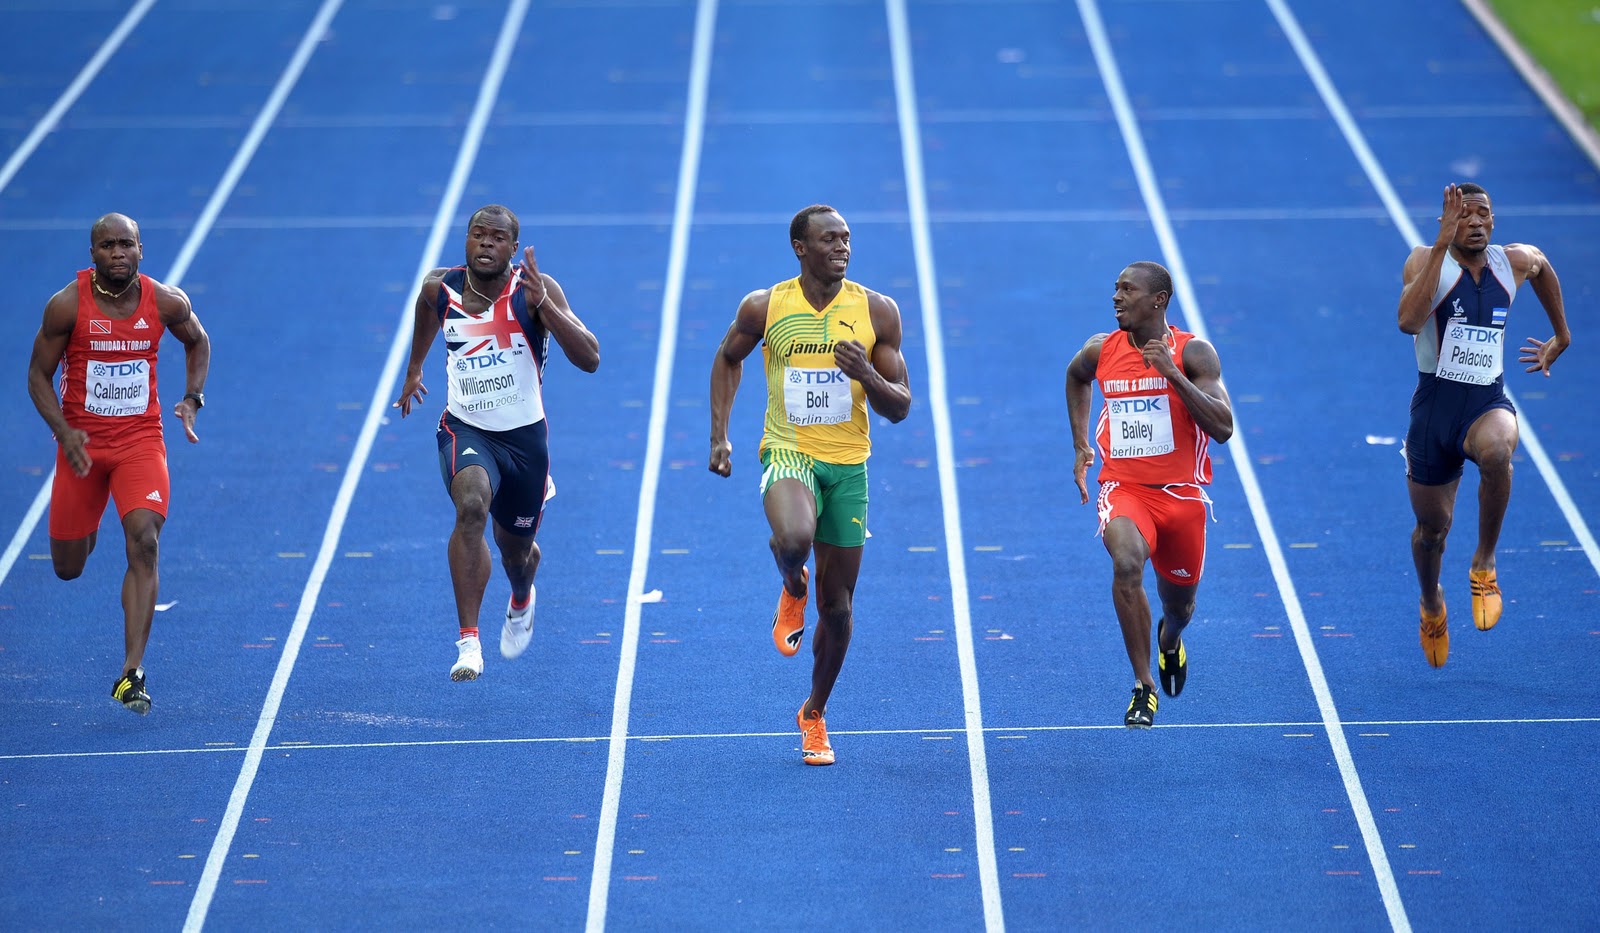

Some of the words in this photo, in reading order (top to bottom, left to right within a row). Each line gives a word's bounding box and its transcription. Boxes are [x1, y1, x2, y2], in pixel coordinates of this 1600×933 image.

[1464, 328, 1499, 344] TDK
[89, 340, 121, 351] TRINIDAD
[121, 340, 127, 351] &
[127, 340, 151, 351] TOBAGO
[466, 351, 507, 370] TDK
[1450, 345, 1493, 369] Palacios
[105, 361, 143, 377] TDK
[1439, 367, 1475, 382] berlin
[459, 373, 515, 396] Williamson
[802, 370, 845, 384] TDK
[94, 382, 142, 400] Callander
[1103, 379, 1130, 393] ANTIGUA
[1131, 379, 1137, 391] &
[495, 393, 518, 407] 2009
[806, 390, 829, 408] Bolt
[1120, 398, 1162, 413] TDK
[87, 403, 123, 415] berlin
[789, 412, 822, 425] berlin
[823, 413, 847, 424] 2009
[1121, 420, 1153, 442] Bailey
[1111, 445, 1144, 457] berlin
[1145, 444, 1170, 455] 2009
